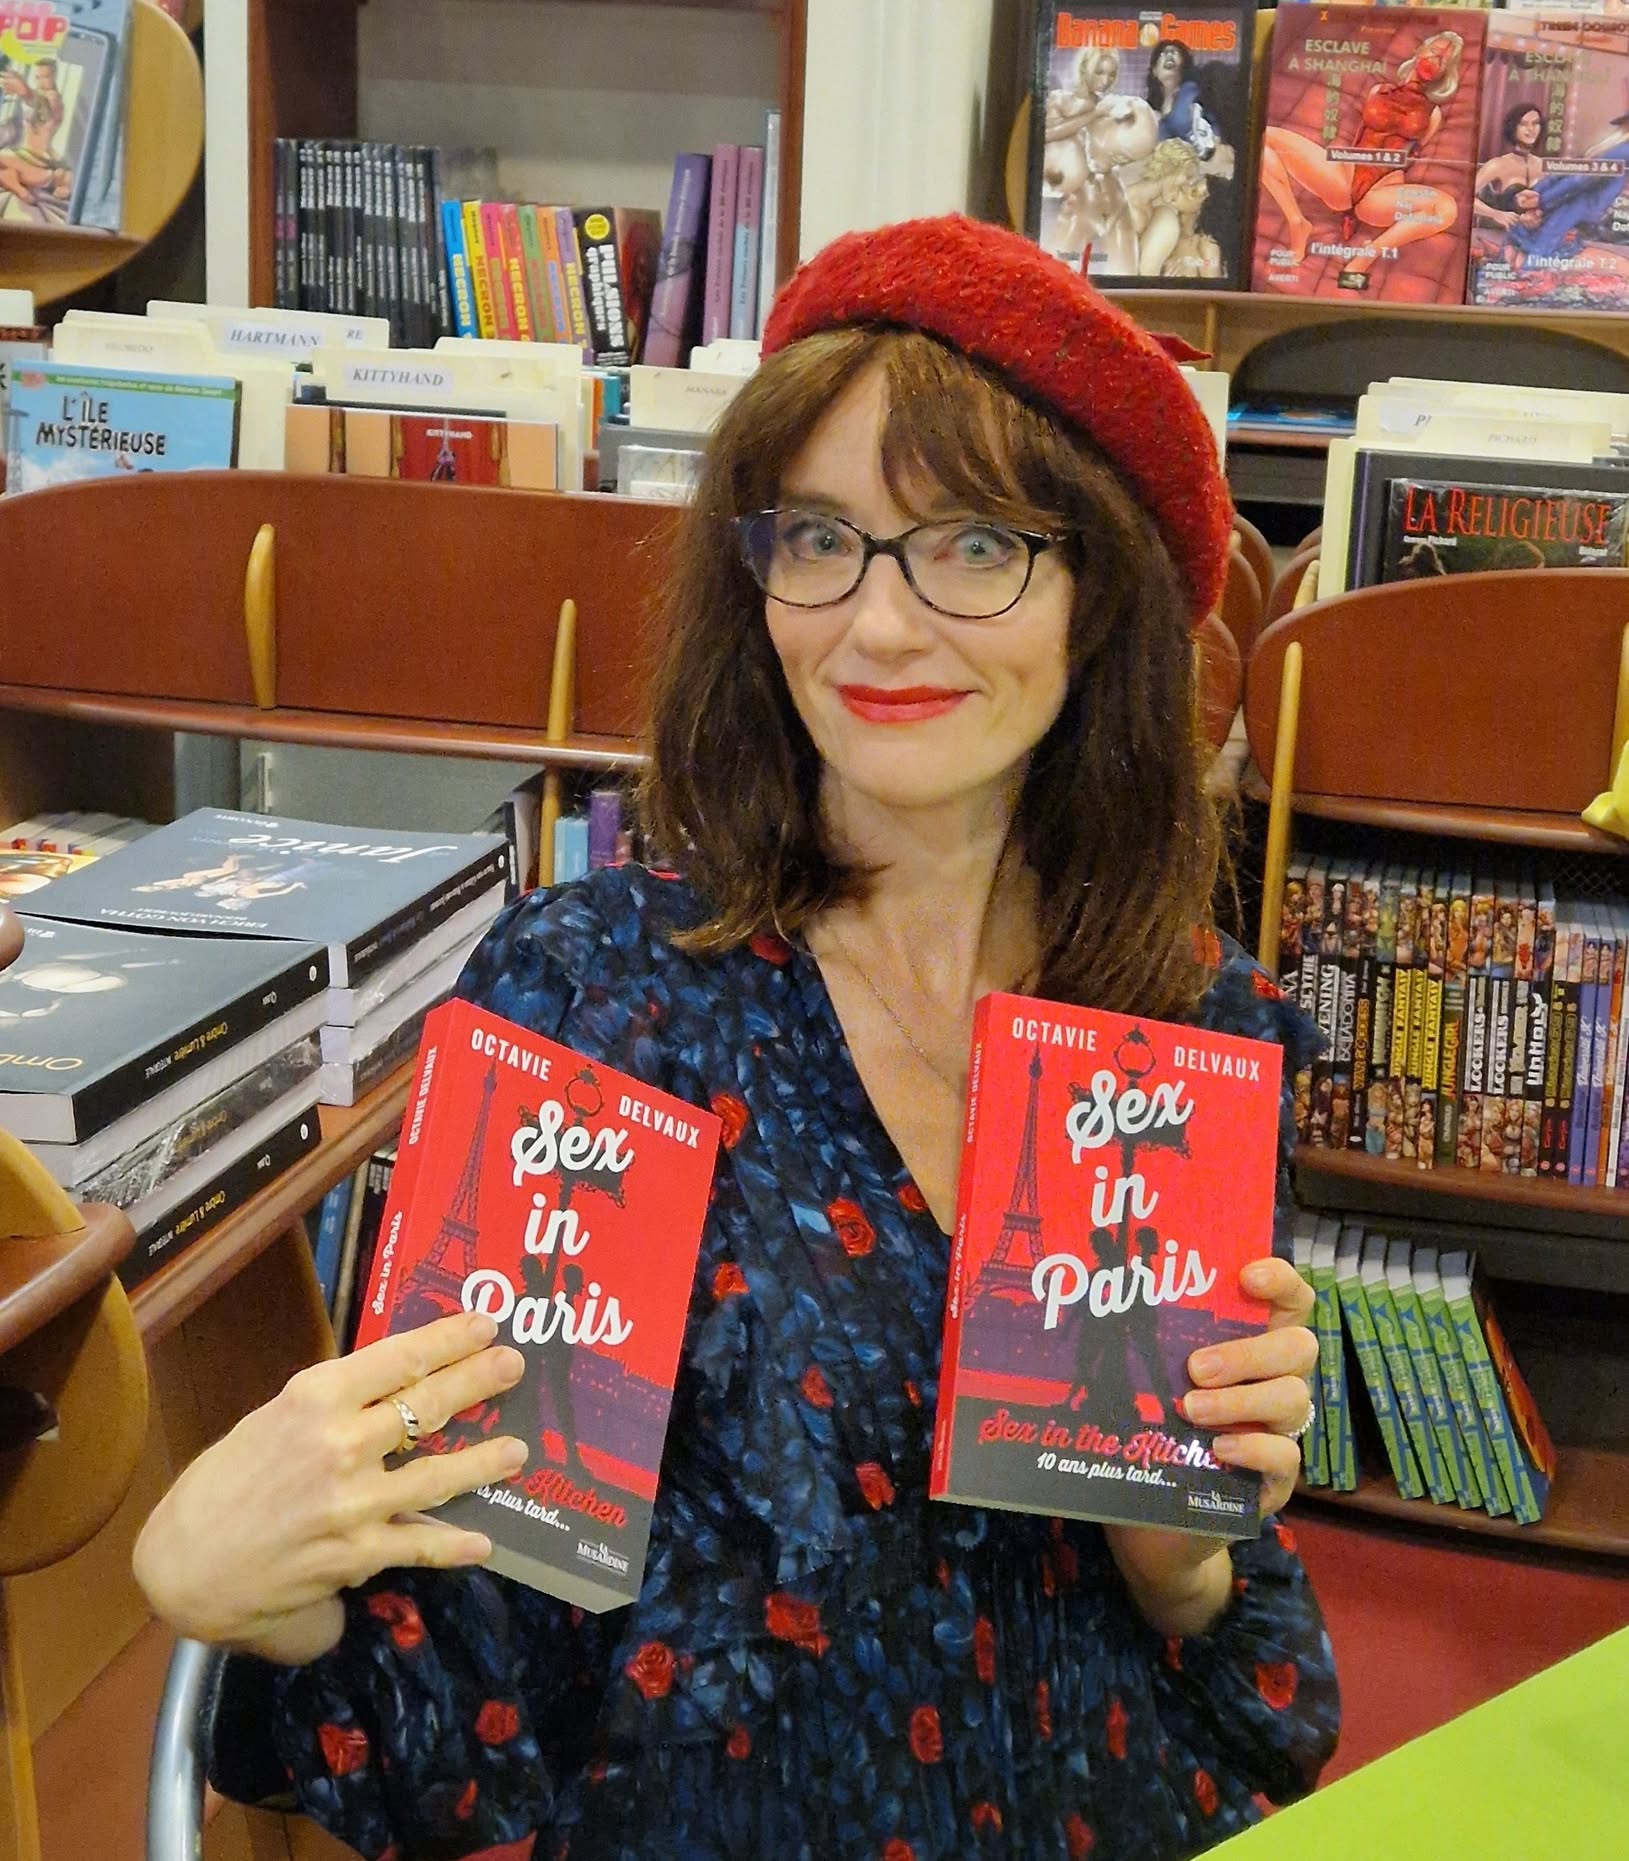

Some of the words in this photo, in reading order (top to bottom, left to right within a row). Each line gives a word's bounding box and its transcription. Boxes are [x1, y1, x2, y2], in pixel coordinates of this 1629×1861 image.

[1056, 12, 1138, 49] Banana
[1160, 14, 1236, 51] Games
[1305, 39, 1370, 55] ESCLAVE
[1304, 58, 1386, 73] SHANGHAI
[1330, 150, 1373, 162] Volumes
[1392, 152, 1400, 162] 2
[1546, 160, 1589, 171] Volumes
[1610, 162, 1618, 171] 4
[452, 253, 471, 326] NECRON
[475, 255, 494, 326] NECRON
[509, 257, 528, 330] NECRON
[566, 262, 586, 335] NECRON
[230, 328, 322, 347] HARTMANN
[352, 367, 444, 387] KITTYHAND
[62, 391, 109, 424] L'ÎLE
[36, 421, 166, 455] MYSTÉRIEUSE
[1403, 486, 1437, 533] LA
[1447, 487, 1612, 545] RELIGIEUSE
[227, 832, 458, 865] Janice
[1427, 979, 1440, 1038] FANTASY
[971, 1041, 984, 1092] DELVAUX
[1012, 1017, 1098, 1053] OCTAVIE
[1173, 1045, 1261, 1083] DELVAUX
[1423, 1041, 1435, 1089] JUNGLE
[1470, 1012, 1485, 1093] LOOKERS
[1493, 1014, 1509, 1095] LOOKERS
[408, 1098, 428, 1145] OCTAVIE
[418, 1045, 439, 1096] DELVAUX
[470, 1028, 552, 1082] OCTAVIE
[618, 1095, 702, 1150] DELVAUX
[966, 1094, 978, 1144] OCTAVIE
[1066, 1069, 1195, 1165] Sex
[511, 1100, 635, 1187] Sex
[1091, 1166, 1160, 1228] in
[381, 1210, 403, 1259] Paris
[524, 1192, 591, 1256] in
[379, 1259, 393, 1279] in
[1031, 1239, 1217, 1330] Paris
[372, 1279, 389, 1316] Sex
[461, 1268, 633, 1345] Paris
[978, 1408, 1038, 1445] Sex
[1040, 1418, 1072, 1449] in
[1074, 1423, 1120, 1456] the
[1122, 1429, 1221, 1471] Kitch
[1036, 1451, 1057, 1471] 10
[1057, 1459, 1087, 1476] ans
[1086, 1459, 1125, 1481] plus
[1124, 1465, 1178, 1488] tard...
[489, 1489, 524, 1513] plus
[523, 1498, 571, 1531] tard...
[524, 1468, 628, 1529] Kitchen
[1187, 1494, 1245, 1513] MUSARDINE
[577, 1542, 629, 1573] MUSARDINE
